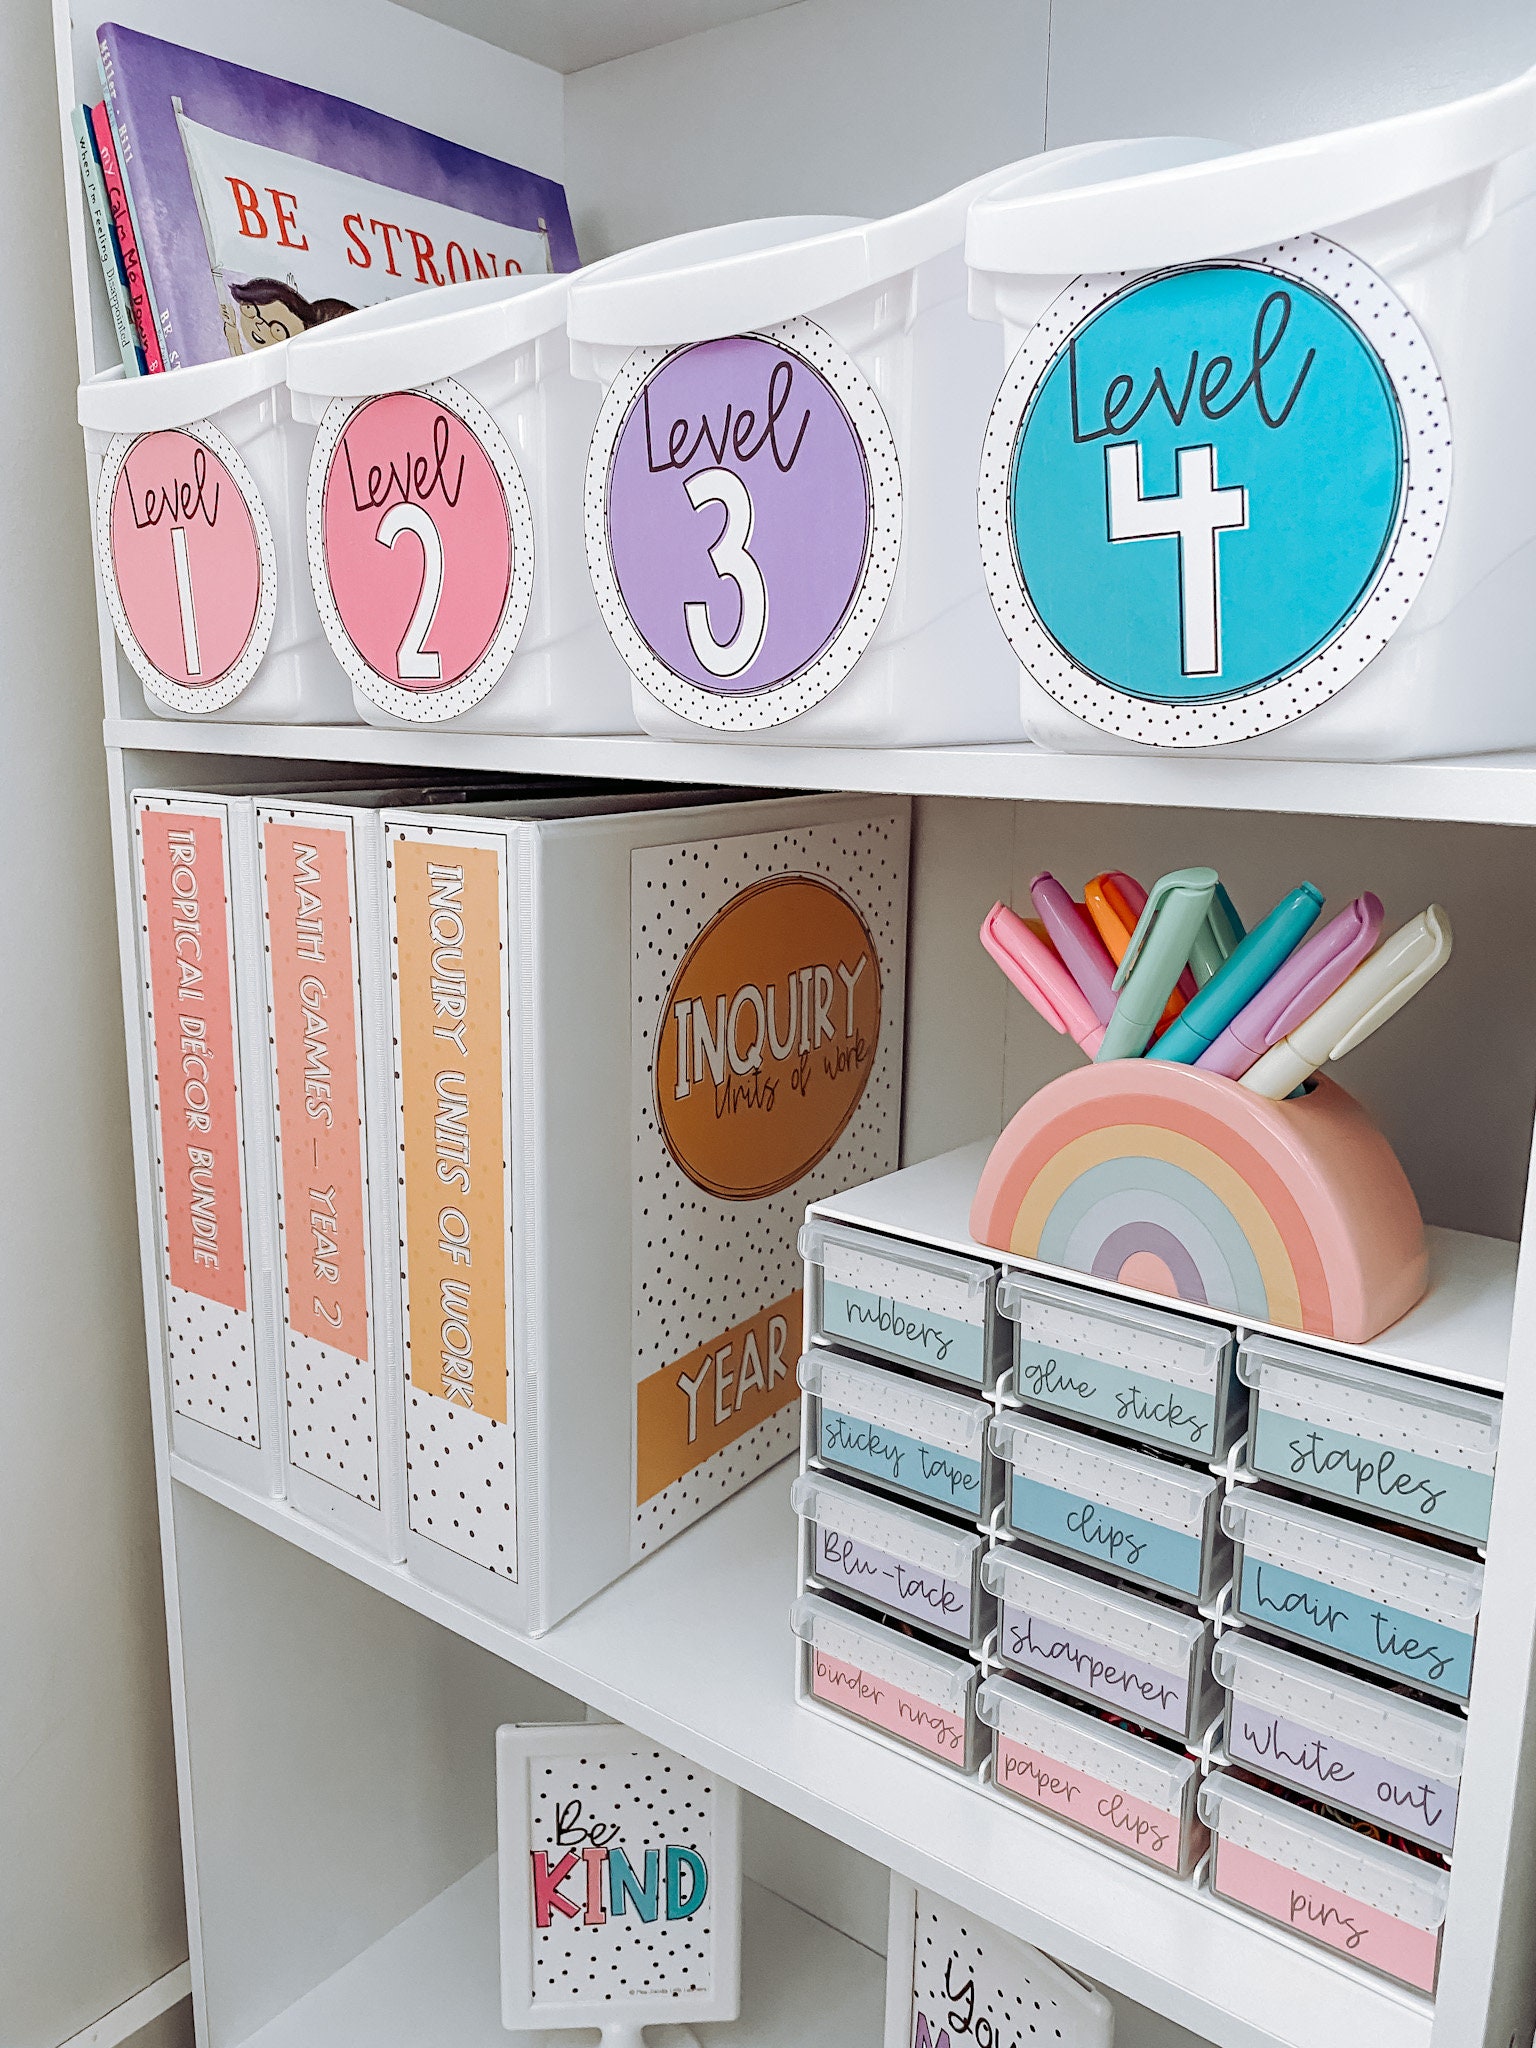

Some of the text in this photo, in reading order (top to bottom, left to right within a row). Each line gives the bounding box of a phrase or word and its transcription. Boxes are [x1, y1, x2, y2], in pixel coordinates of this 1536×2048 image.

[79, 136, 90, 177] When
[94, 209, 109, 263] Feeling
[105, 266, 131, 348] Disappointed
[109, 187, 127, 242] Calm
[224, 176, 309, 251] BE
[643, 361, 811, 473] Level
[1069, 291, 1316, 444] Level
[123, 448, 220, 529] Level
[343, 415, 465, 512] Level
[170, 526, 202, 677] 1
[375, 501, 444, 680] 2
[682, 466, 769, 680] 3
[1103, 440, 1250, 679] 4
[291, 840, 327, 964] MATH
[166, 828, 220, 1271] TROPICAL DÉCOR BUNDLE
[298, 974, 334, 1129] GAMES
[673, 951, 868, 1101] INQUIRY
[715, 1028, 869, 1119] Units of work
[426, 861, 474, 1410] INQUIRY UNITS OF WORK
[308, 1184, 341, 1286] YEAR
[312, 1295, 343, 1329] 2
[846, 1295, 954, 1361] rubbers
[676, 1314, 789, 1446] YEAR
[1024, 1359, 1209, 1443] glue sticks
[825, 1417, 980, 1495] sticky tape
[1289, 1431, 1447, 1514] staples
[823, 1530, 964, 1616] Blu-tack
[1066, 1505, 1147, 1565] clips
[1010, 1618, 1180, 1710] sharpener
[1257, 1566, 1455, 1680] hair ties
[815, 1649, 963, 1749] binder rings
[556, 1799, 621, 1848] Be
[1004, 1751, 1170, 1852] paper clips
[1243, 1720, 1443, 1827] white out
[530, 1844, 709, 1928] KIND
[1290, 1889, 1369, 1949] pins
